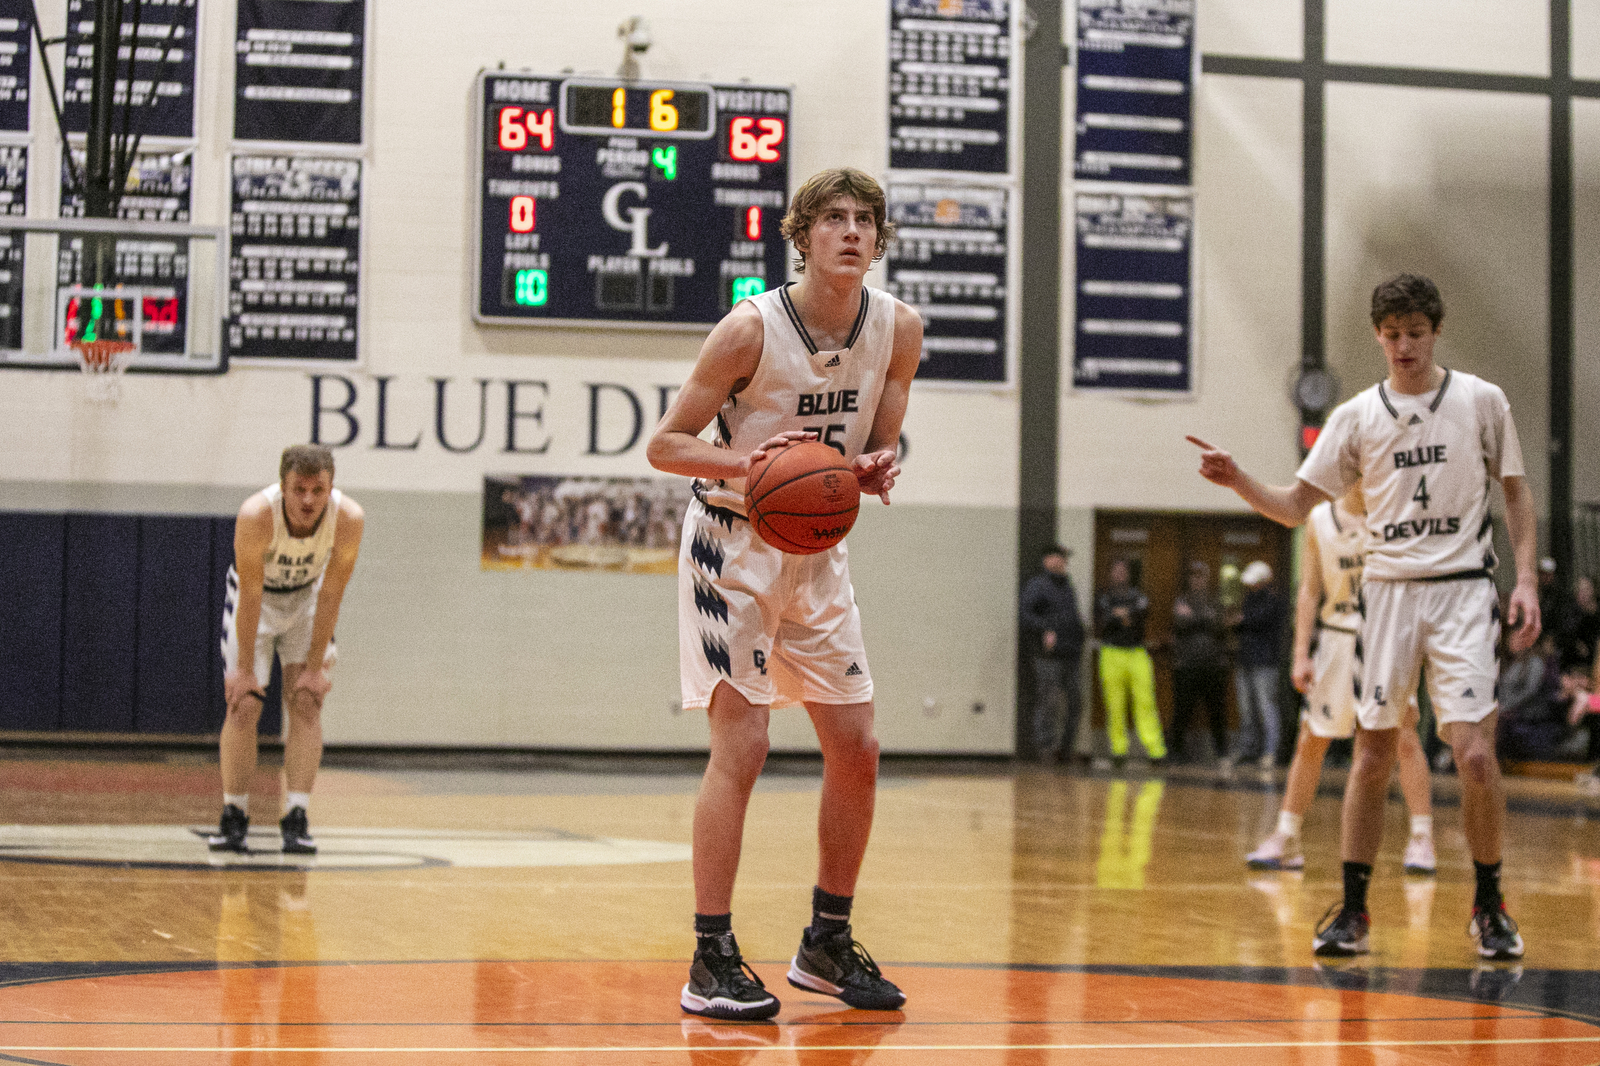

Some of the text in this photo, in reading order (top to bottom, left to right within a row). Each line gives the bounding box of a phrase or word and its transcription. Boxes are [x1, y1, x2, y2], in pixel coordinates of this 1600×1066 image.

[493, 80, 551, 102] HOME
[499, 106, 554, 151] 64
[729, 116, 785, 163] 62
[652, 145, 677, 180] 4
[509, 195, 536, 233] 0
[746, 206, 762, 241] 1
[514, 269, 548, 307] 10
[305, 373, 552, 455] BLUE
[795, 389, 859, 417] BLUE
[1393, 445, 1448, 470] BLUE
[1412, 474, 1431, 510] 4
[1384, 517, 1461, 542] DEVILS
